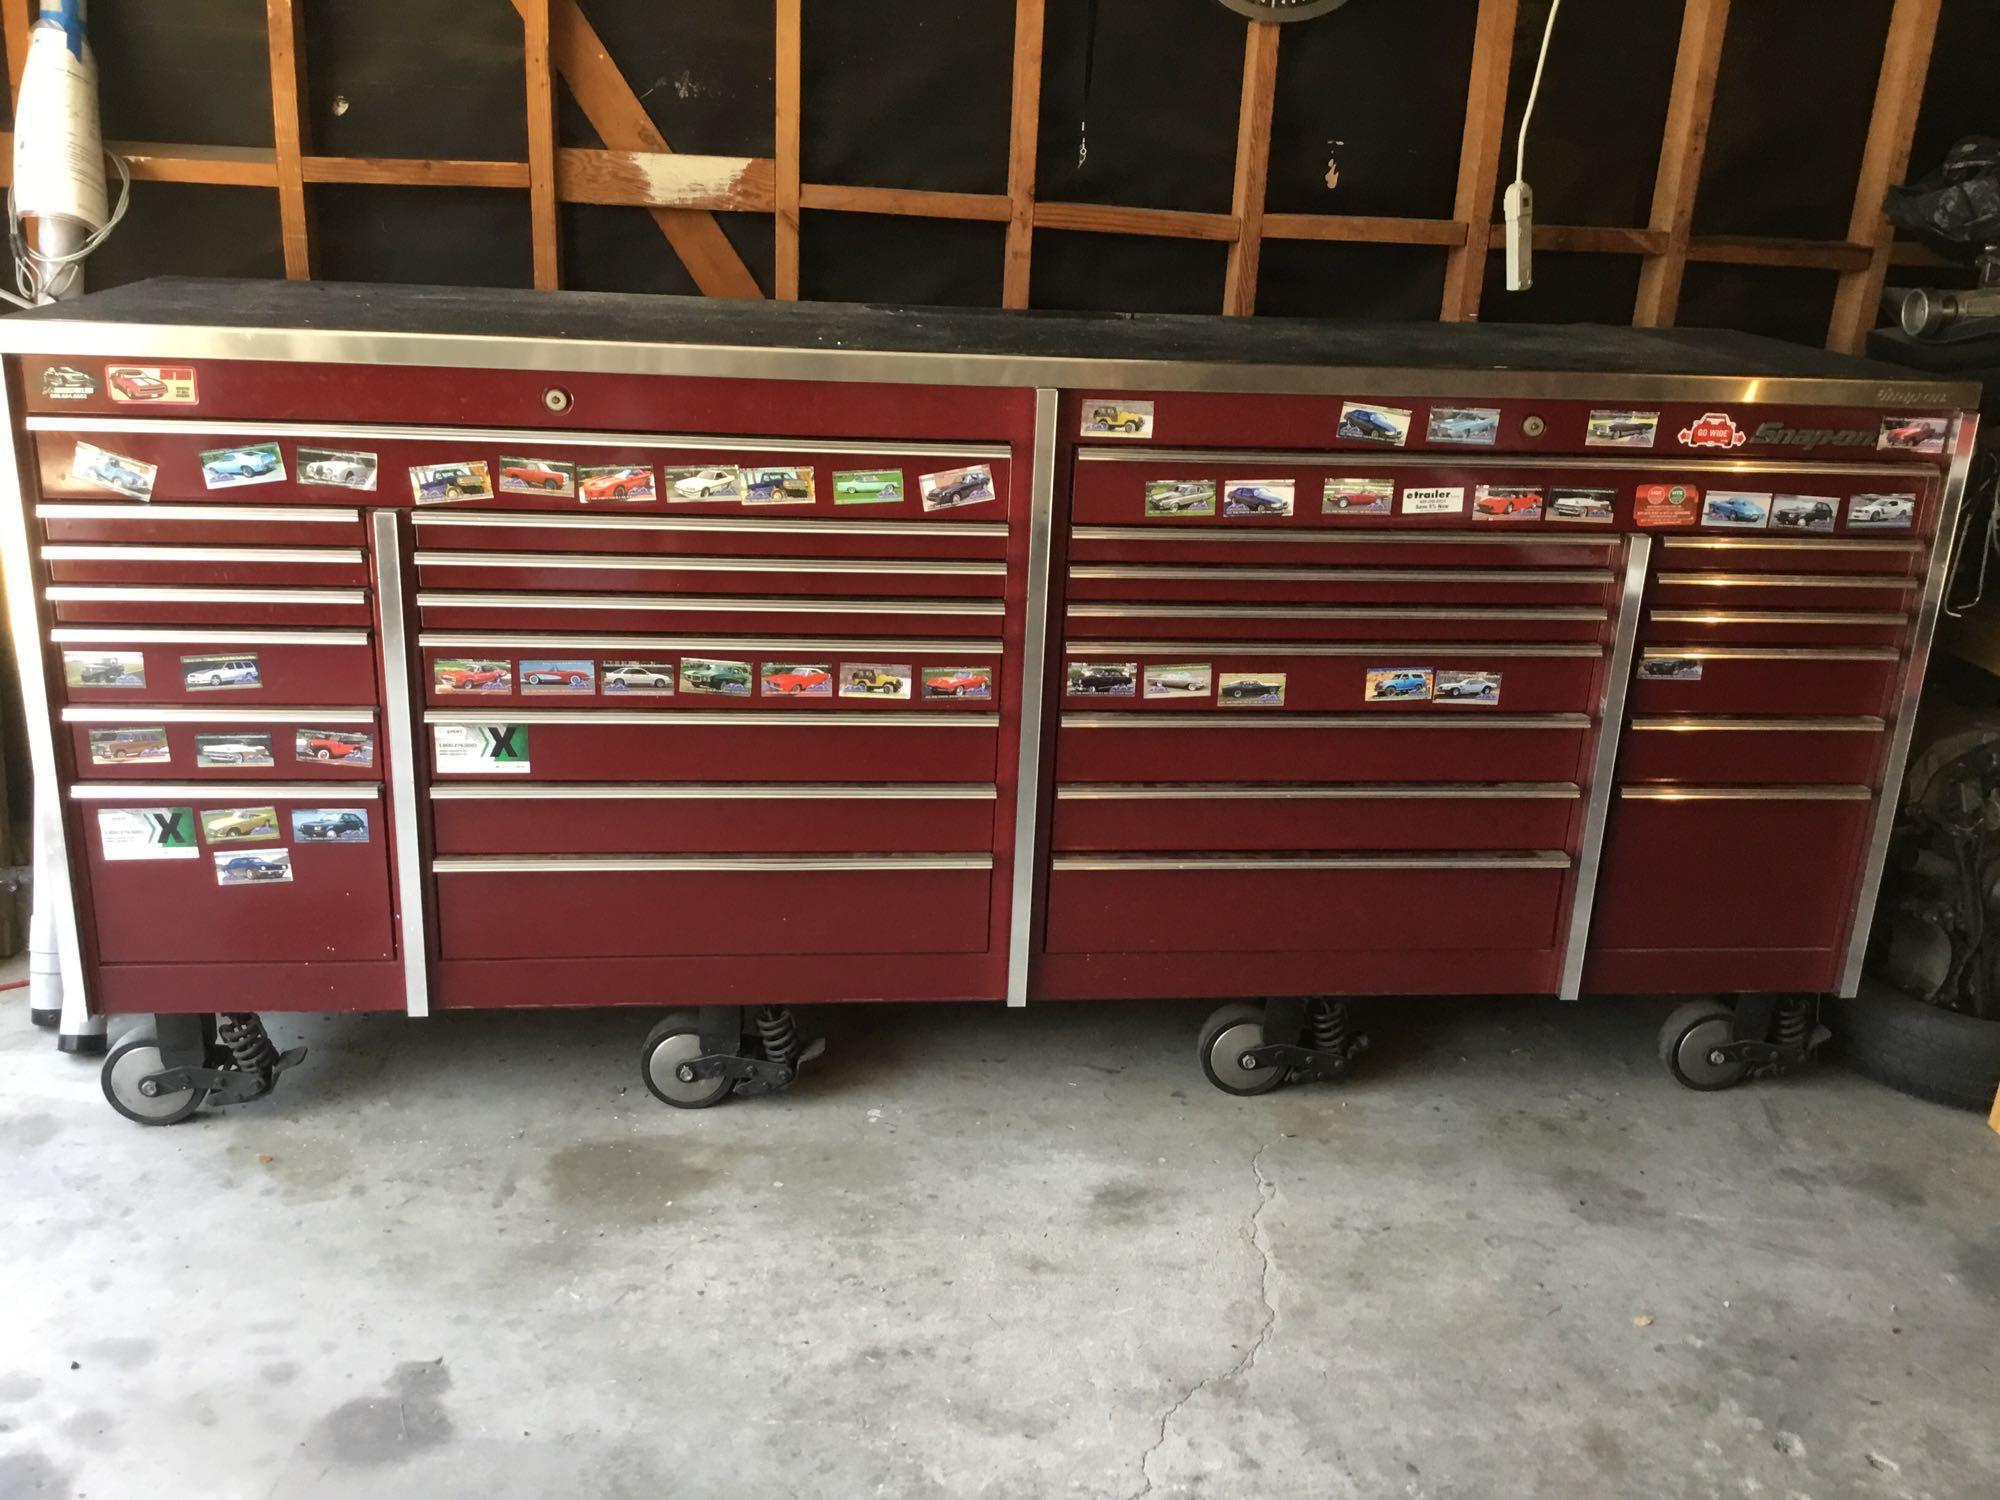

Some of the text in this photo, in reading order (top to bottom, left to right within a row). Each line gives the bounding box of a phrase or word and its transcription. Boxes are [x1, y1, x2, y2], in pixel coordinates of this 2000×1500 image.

[1697, 428, 1729, 438] GO WIDE
[1749, 421, 1877, 451] Snap-on
[1406, 490, 1451, 499] etrailer
[488, 726, 518, 757] X
[153, 812, 185, 843] X
